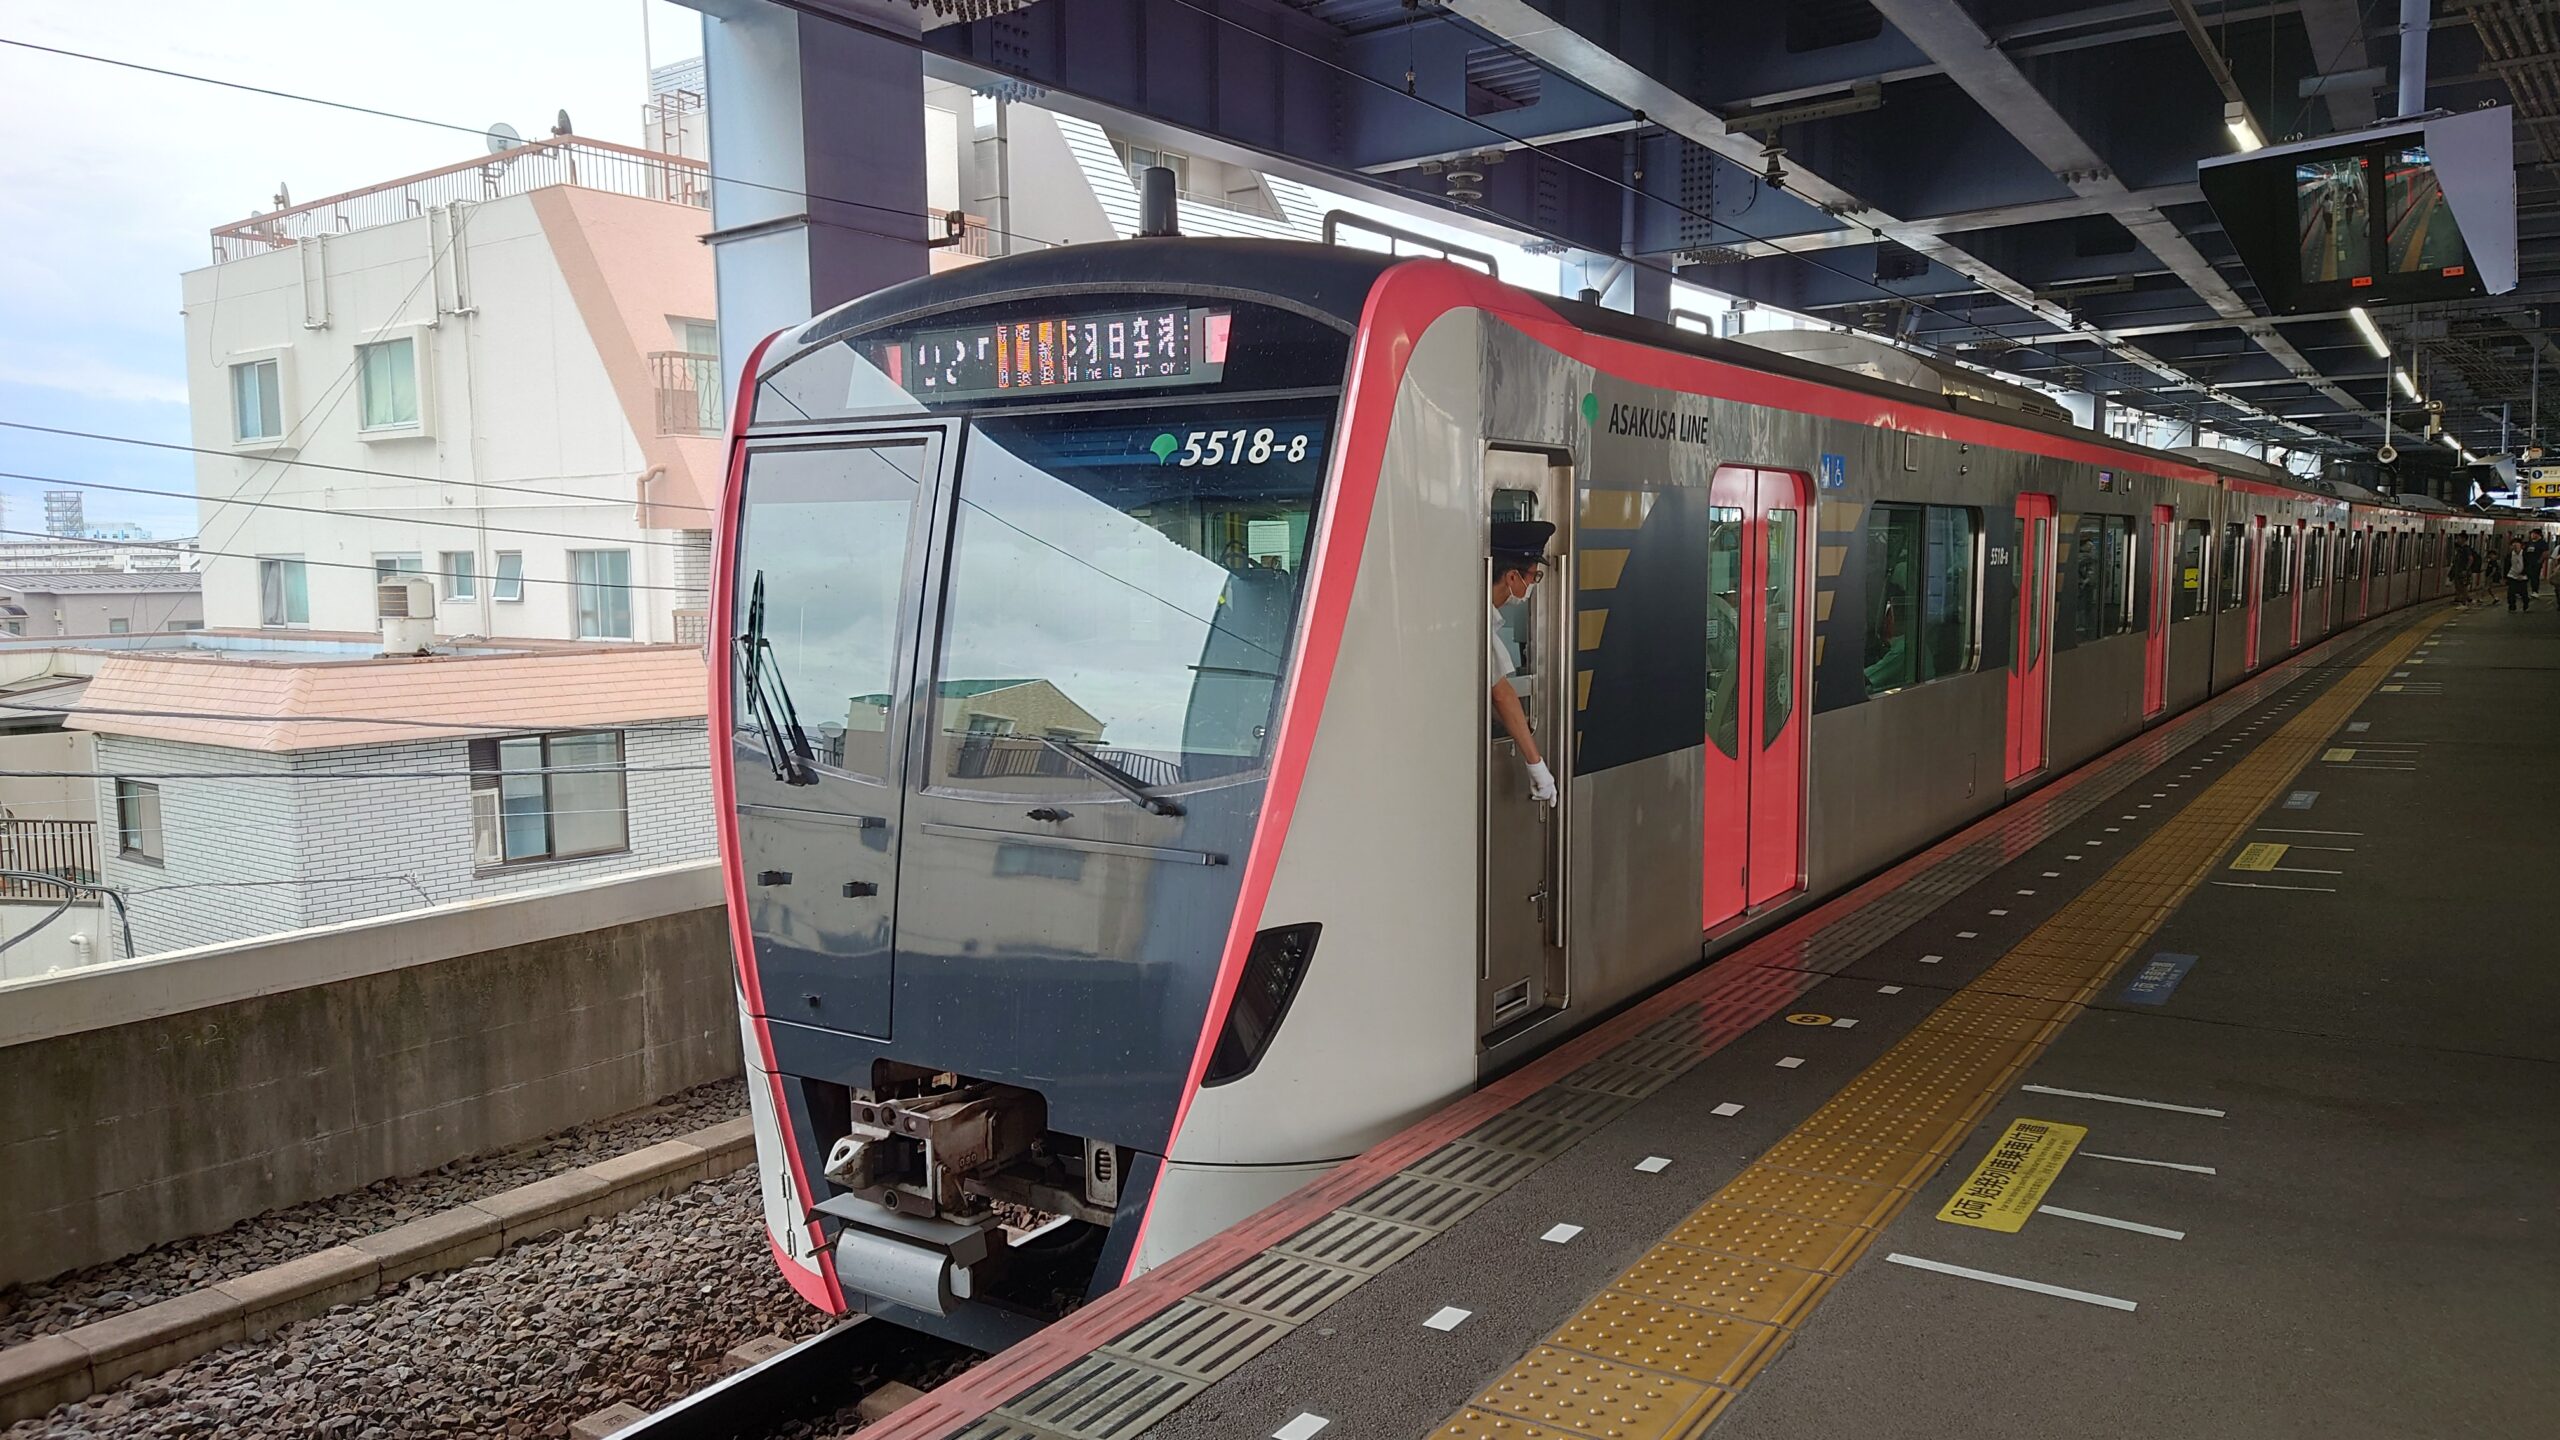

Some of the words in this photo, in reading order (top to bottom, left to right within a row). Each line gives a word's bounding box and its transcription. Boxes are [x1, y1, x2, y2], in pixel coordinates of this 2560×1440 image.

[1608, 403, 1676, 441] ASAKUSA
[1679, 414, 1709, 444] LINE
[1179, 427, 1308, 467] 5518-8
[1990, 546, 2009, 566] 5518-8
